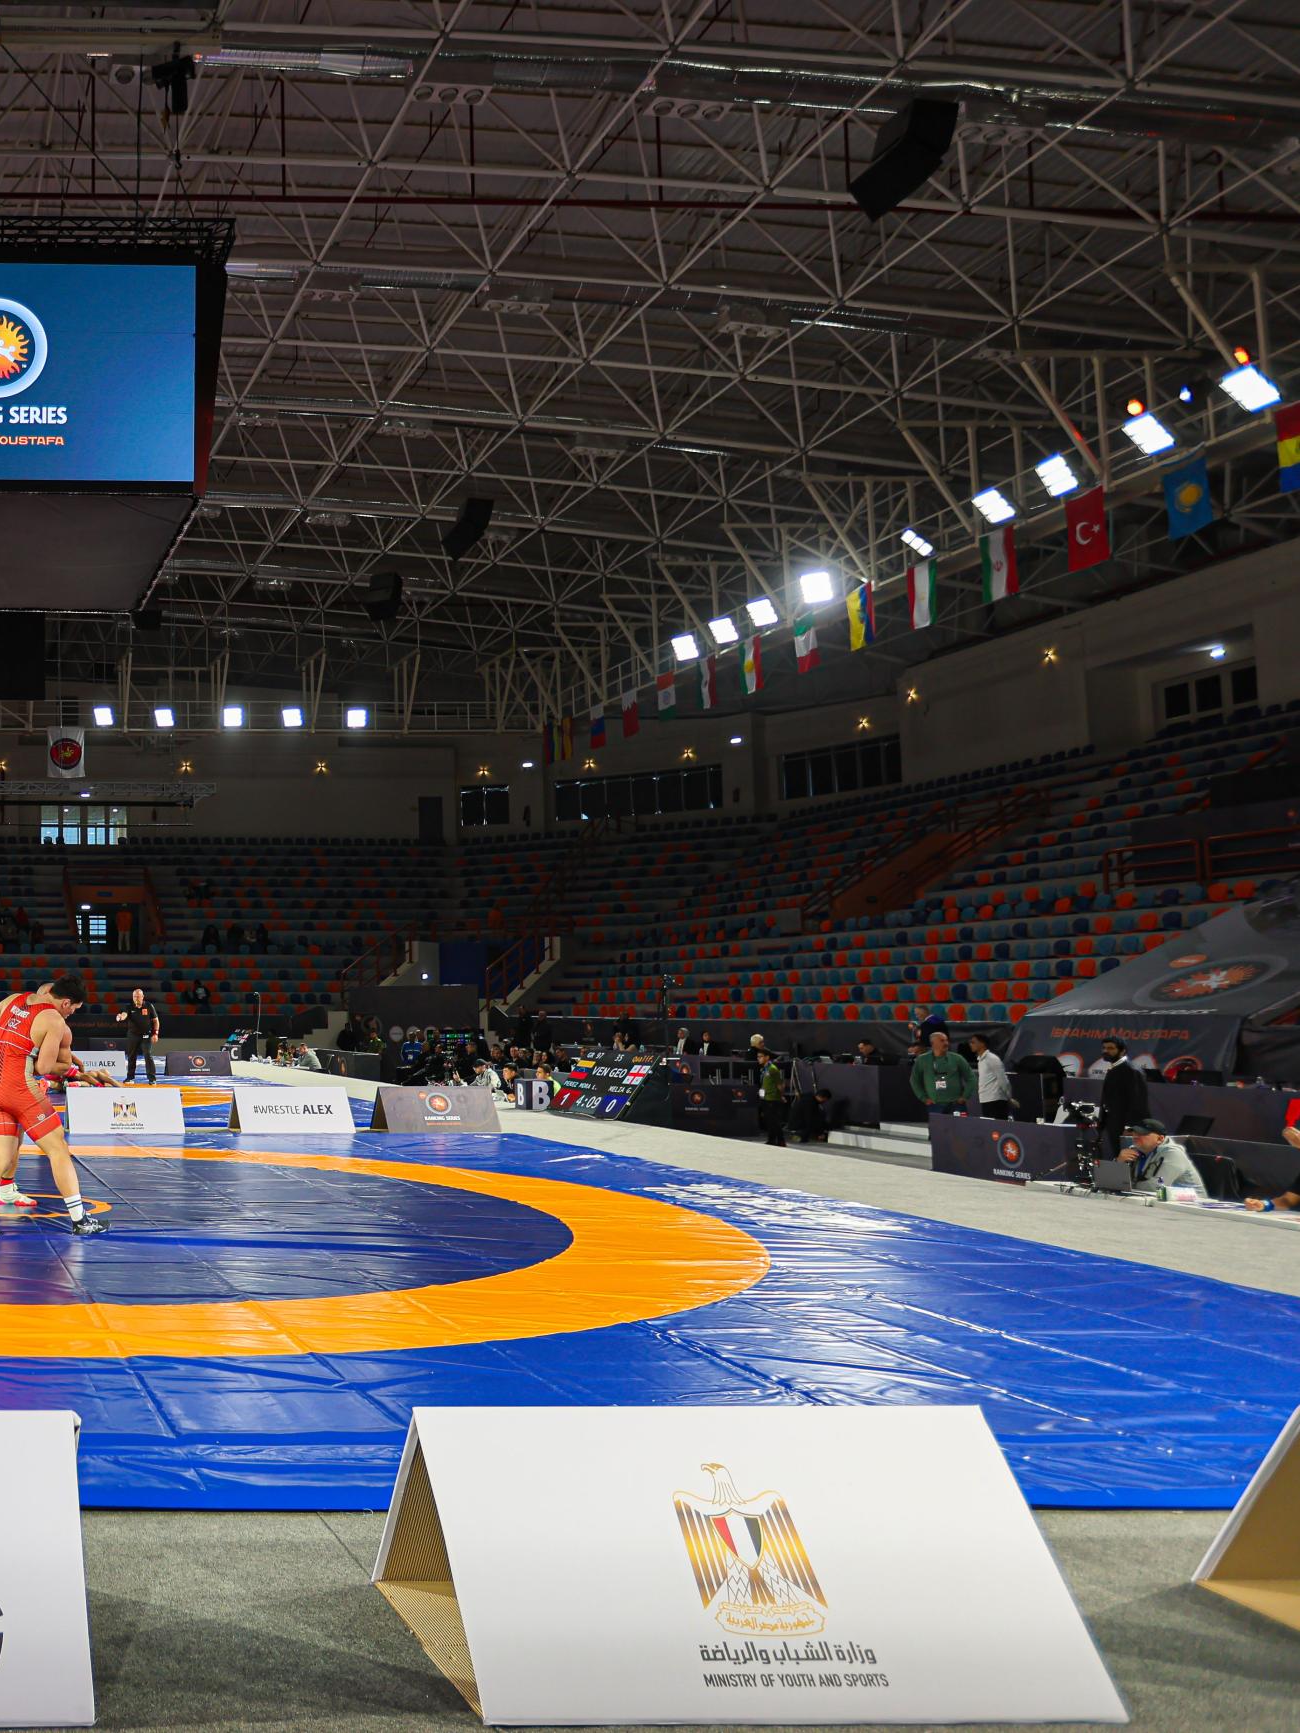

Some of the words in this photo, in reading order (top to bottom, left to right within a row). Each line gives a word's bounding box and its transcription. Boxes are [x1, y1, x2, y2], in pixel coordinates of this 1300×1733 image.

[9, 406, 68, 425] SERIES
[230, 1047, 239, 1060] C
[592, 1066, 610, 1077] VEN
[609, 1068, 628, 1079] GEO
[517, 1083, 525, 1106] B
[532, 1081, 551, 1111] B
[560, 1093, 571, 1105] 1
[576, 1095, 602, 1109] 4:09
[605, 1099, 617, 1113] 0
[253, 1104, 300, 1115] #WRESTLE
[303, 1104, 334, 1115] ALEX
[993, 1168, 1015, 1178] RANKING
[1015, 1171, 1031, 1180] SERIES
[699, 1641, 772, 1665] والرياضة
[773, 1641, 833, 1665] الشباب
[833, 1641, 877, 1665] وزارة
[703, 1673, 757, 1688] MINISTRY
[762, 1673, 776, 1688] OF
[776, 1673, 817, 1688] YOUTH
[818, 1673, 842, 1688] AND
[844, 1673, 890, 1688] SPORTS
